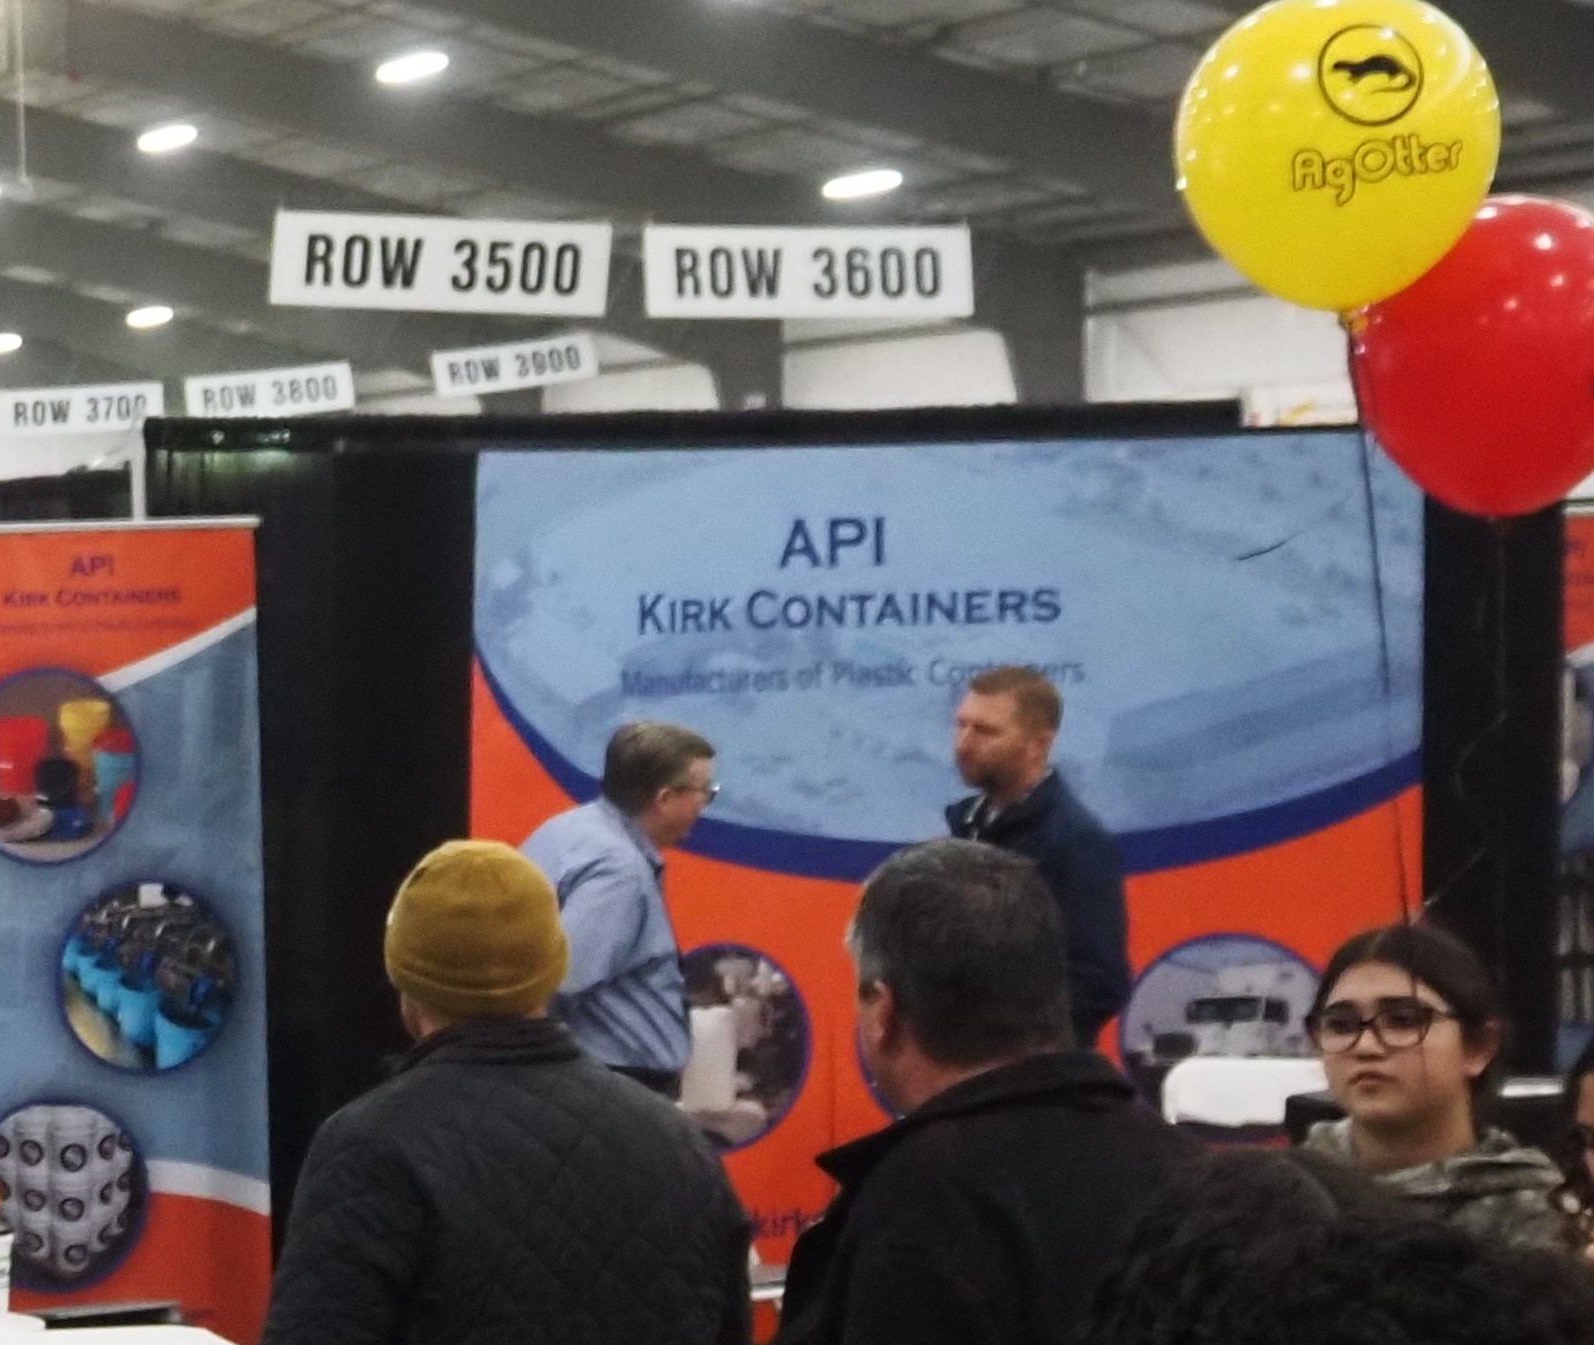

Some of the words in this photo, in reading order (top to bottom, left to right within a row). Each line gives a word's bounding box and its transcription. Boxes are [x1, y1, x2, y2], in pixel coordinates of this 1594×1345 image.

[1292, 134, 1462, 206] AgOtter
[304, 234, 423, 292] ROW
[450, 240, 581, 296] 3500
[674, 247, 782, 298] ROW
[812, 246, 942, 298] 3600
[202, 382, 257, 412] ROW
[271, 375, 338, 406] 3800
[448, 358, 499, 386] ROW
[13, 400, 70, 427] ROW
[87, 394, 147, 423] 3700
[69, 555, 114, 577] API
[779, 516, 886, 569] API
[638, 592, 737, 635] KIRK
[746, 587, 1062, 631] CONTAINERS
